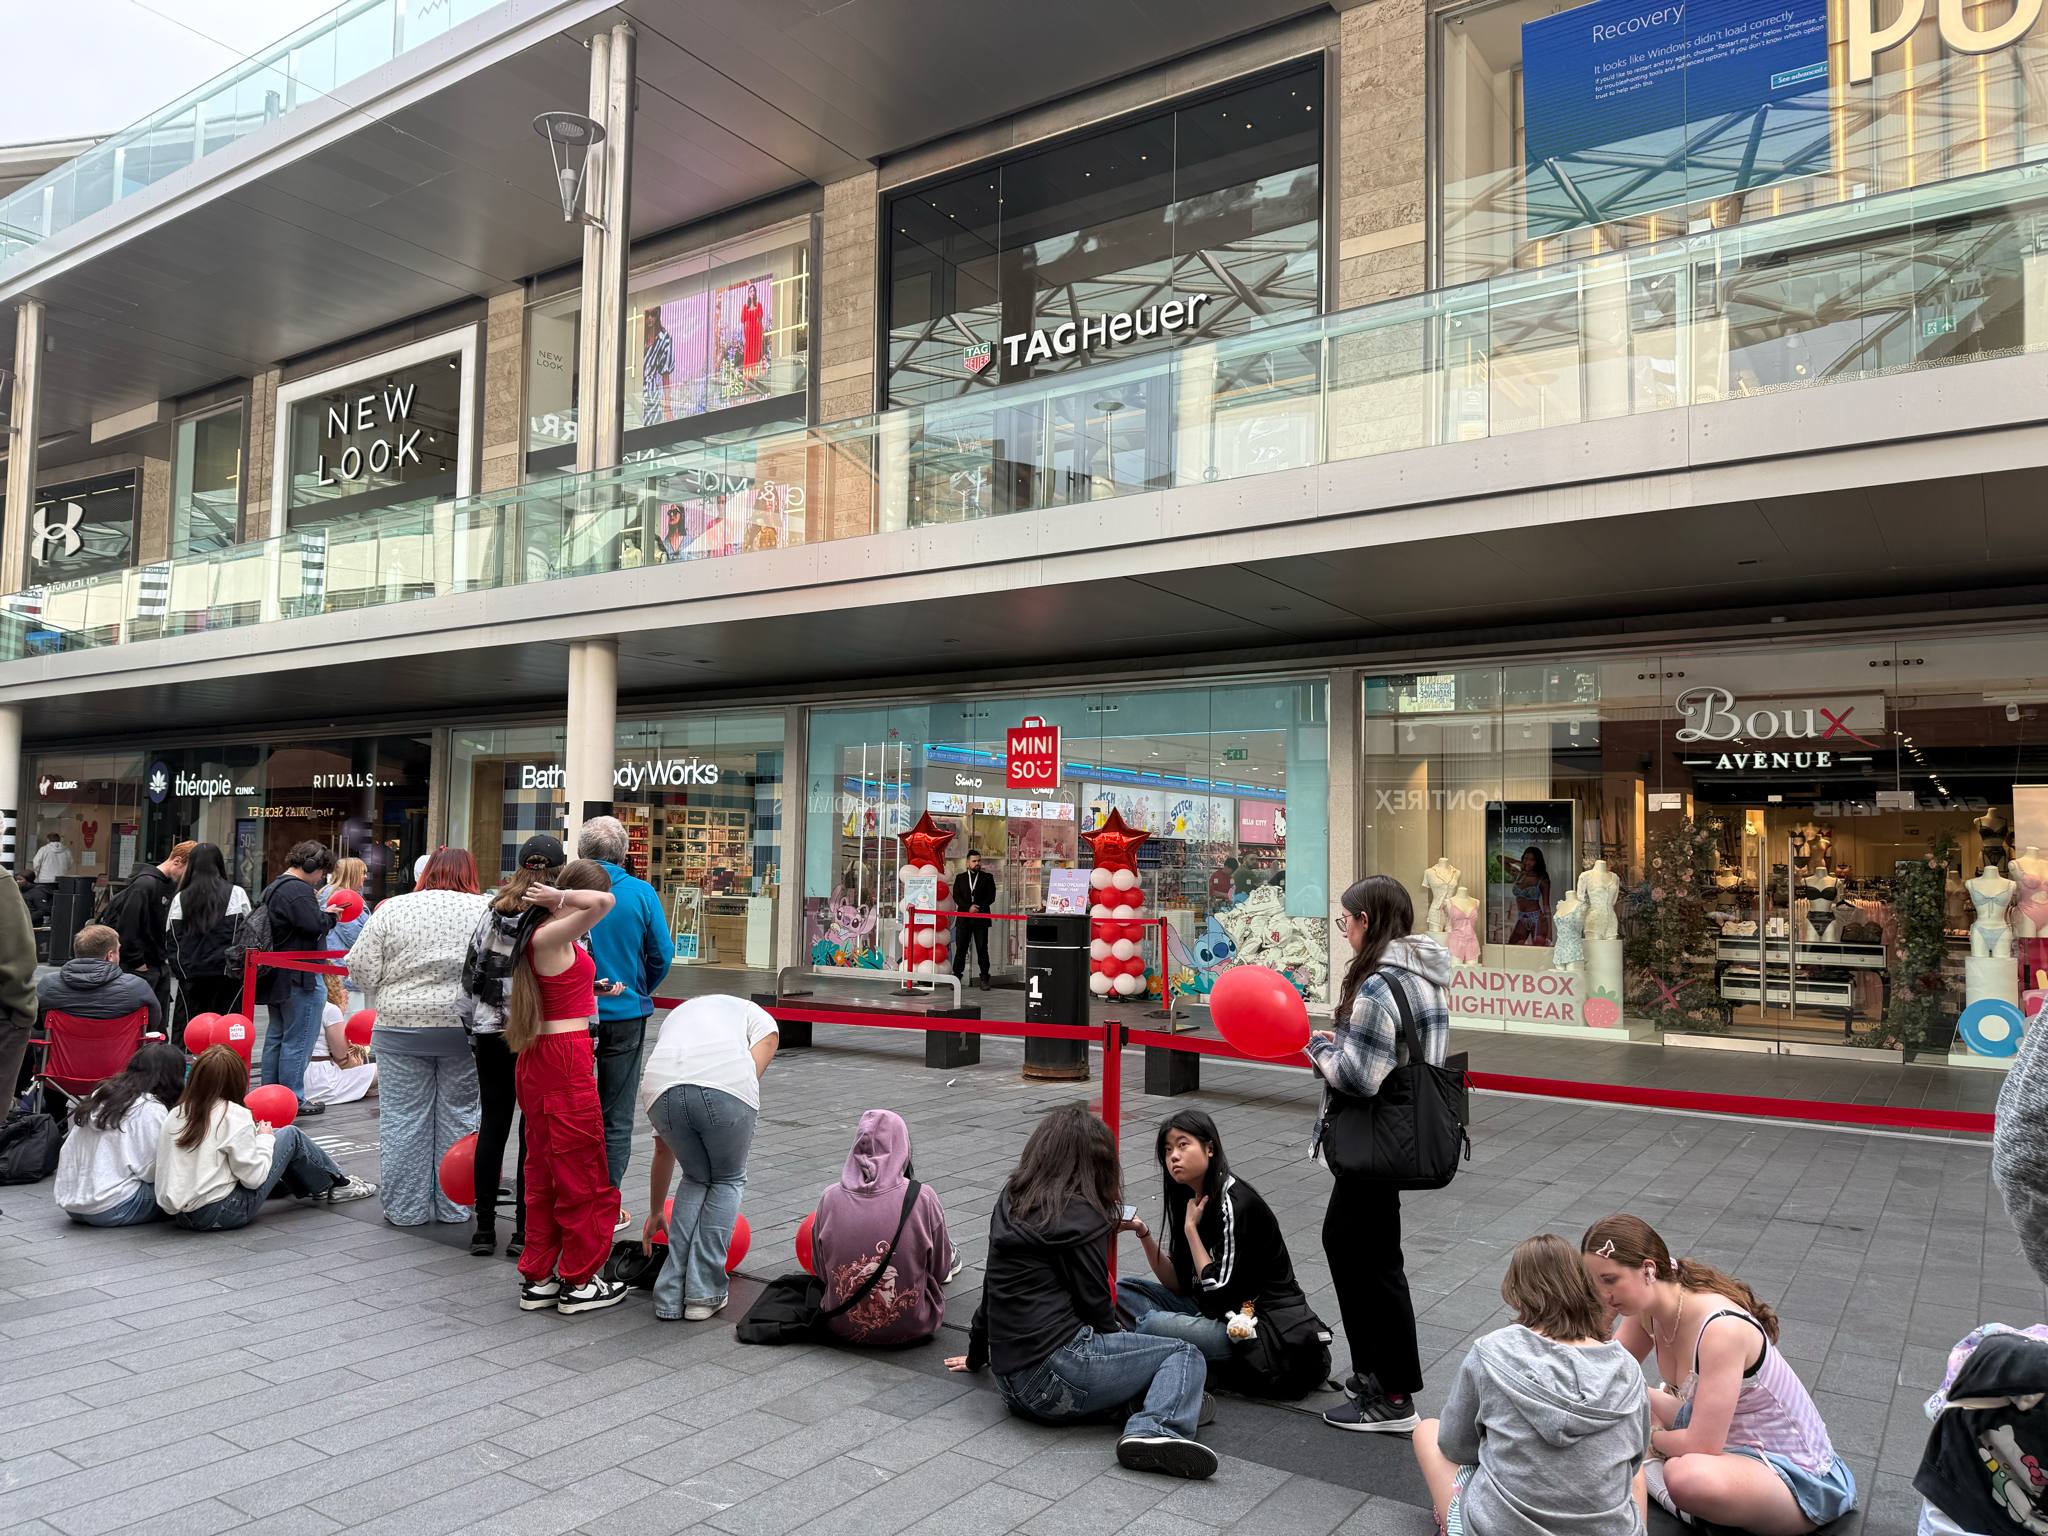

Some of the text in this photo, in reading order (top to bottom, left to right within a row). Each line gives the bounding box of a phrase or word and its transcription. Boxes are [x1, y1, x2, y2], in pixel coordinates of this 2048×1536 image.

[1593, 4, 1684, 43] Recovery
[1594, 10, 1794, 74] It looks like Windows didn't load correctly
[1634, 64, 1652, 73] restart
[1653, 60, 1665, 68] and
[1665, 57, 1674, 66] try
[1693, 46, 1715, 57] choose
[1740, 36, 1749, 44] my
[1649, 69, 1664, 78] tools
[1664, 65, 1676, 73] and
[1735, 45, 1748, 55] you
[1765, 36, 1782, 45] know
[1783, 30, 1802, 40] which
[1803, 24, 1824, 35] option
[1616, 86, 1629, 96] help
[1630, 82, 1642, 91] with
[539, 350, 562, 362] NEW
[966, 344, 989, 356] TAG
[1003, 323, 1077, 367] TAG
[537, 358, 564, 372] LOOK
[964, 355, 989, 370] HEUER
[328, 383, 415, 439] NEW
[319, 429, 421, 486] LOOK
[1675, 686, 1881, 748] Boux
[1011, 736, 1052, 755] MINI
[1715, 752, 1832, 770] AVENUE
[175, 770, 232, 802] thérapie
[522, 759, 719, 792] Bath dy Works
[1171, 799, 1193, 822] STITCH
[1511, 815, 1547, 825] HELLO,
[1029, 975, 1043, 998] 1
[1451, 970, 1575, 996] ANDYBOX
